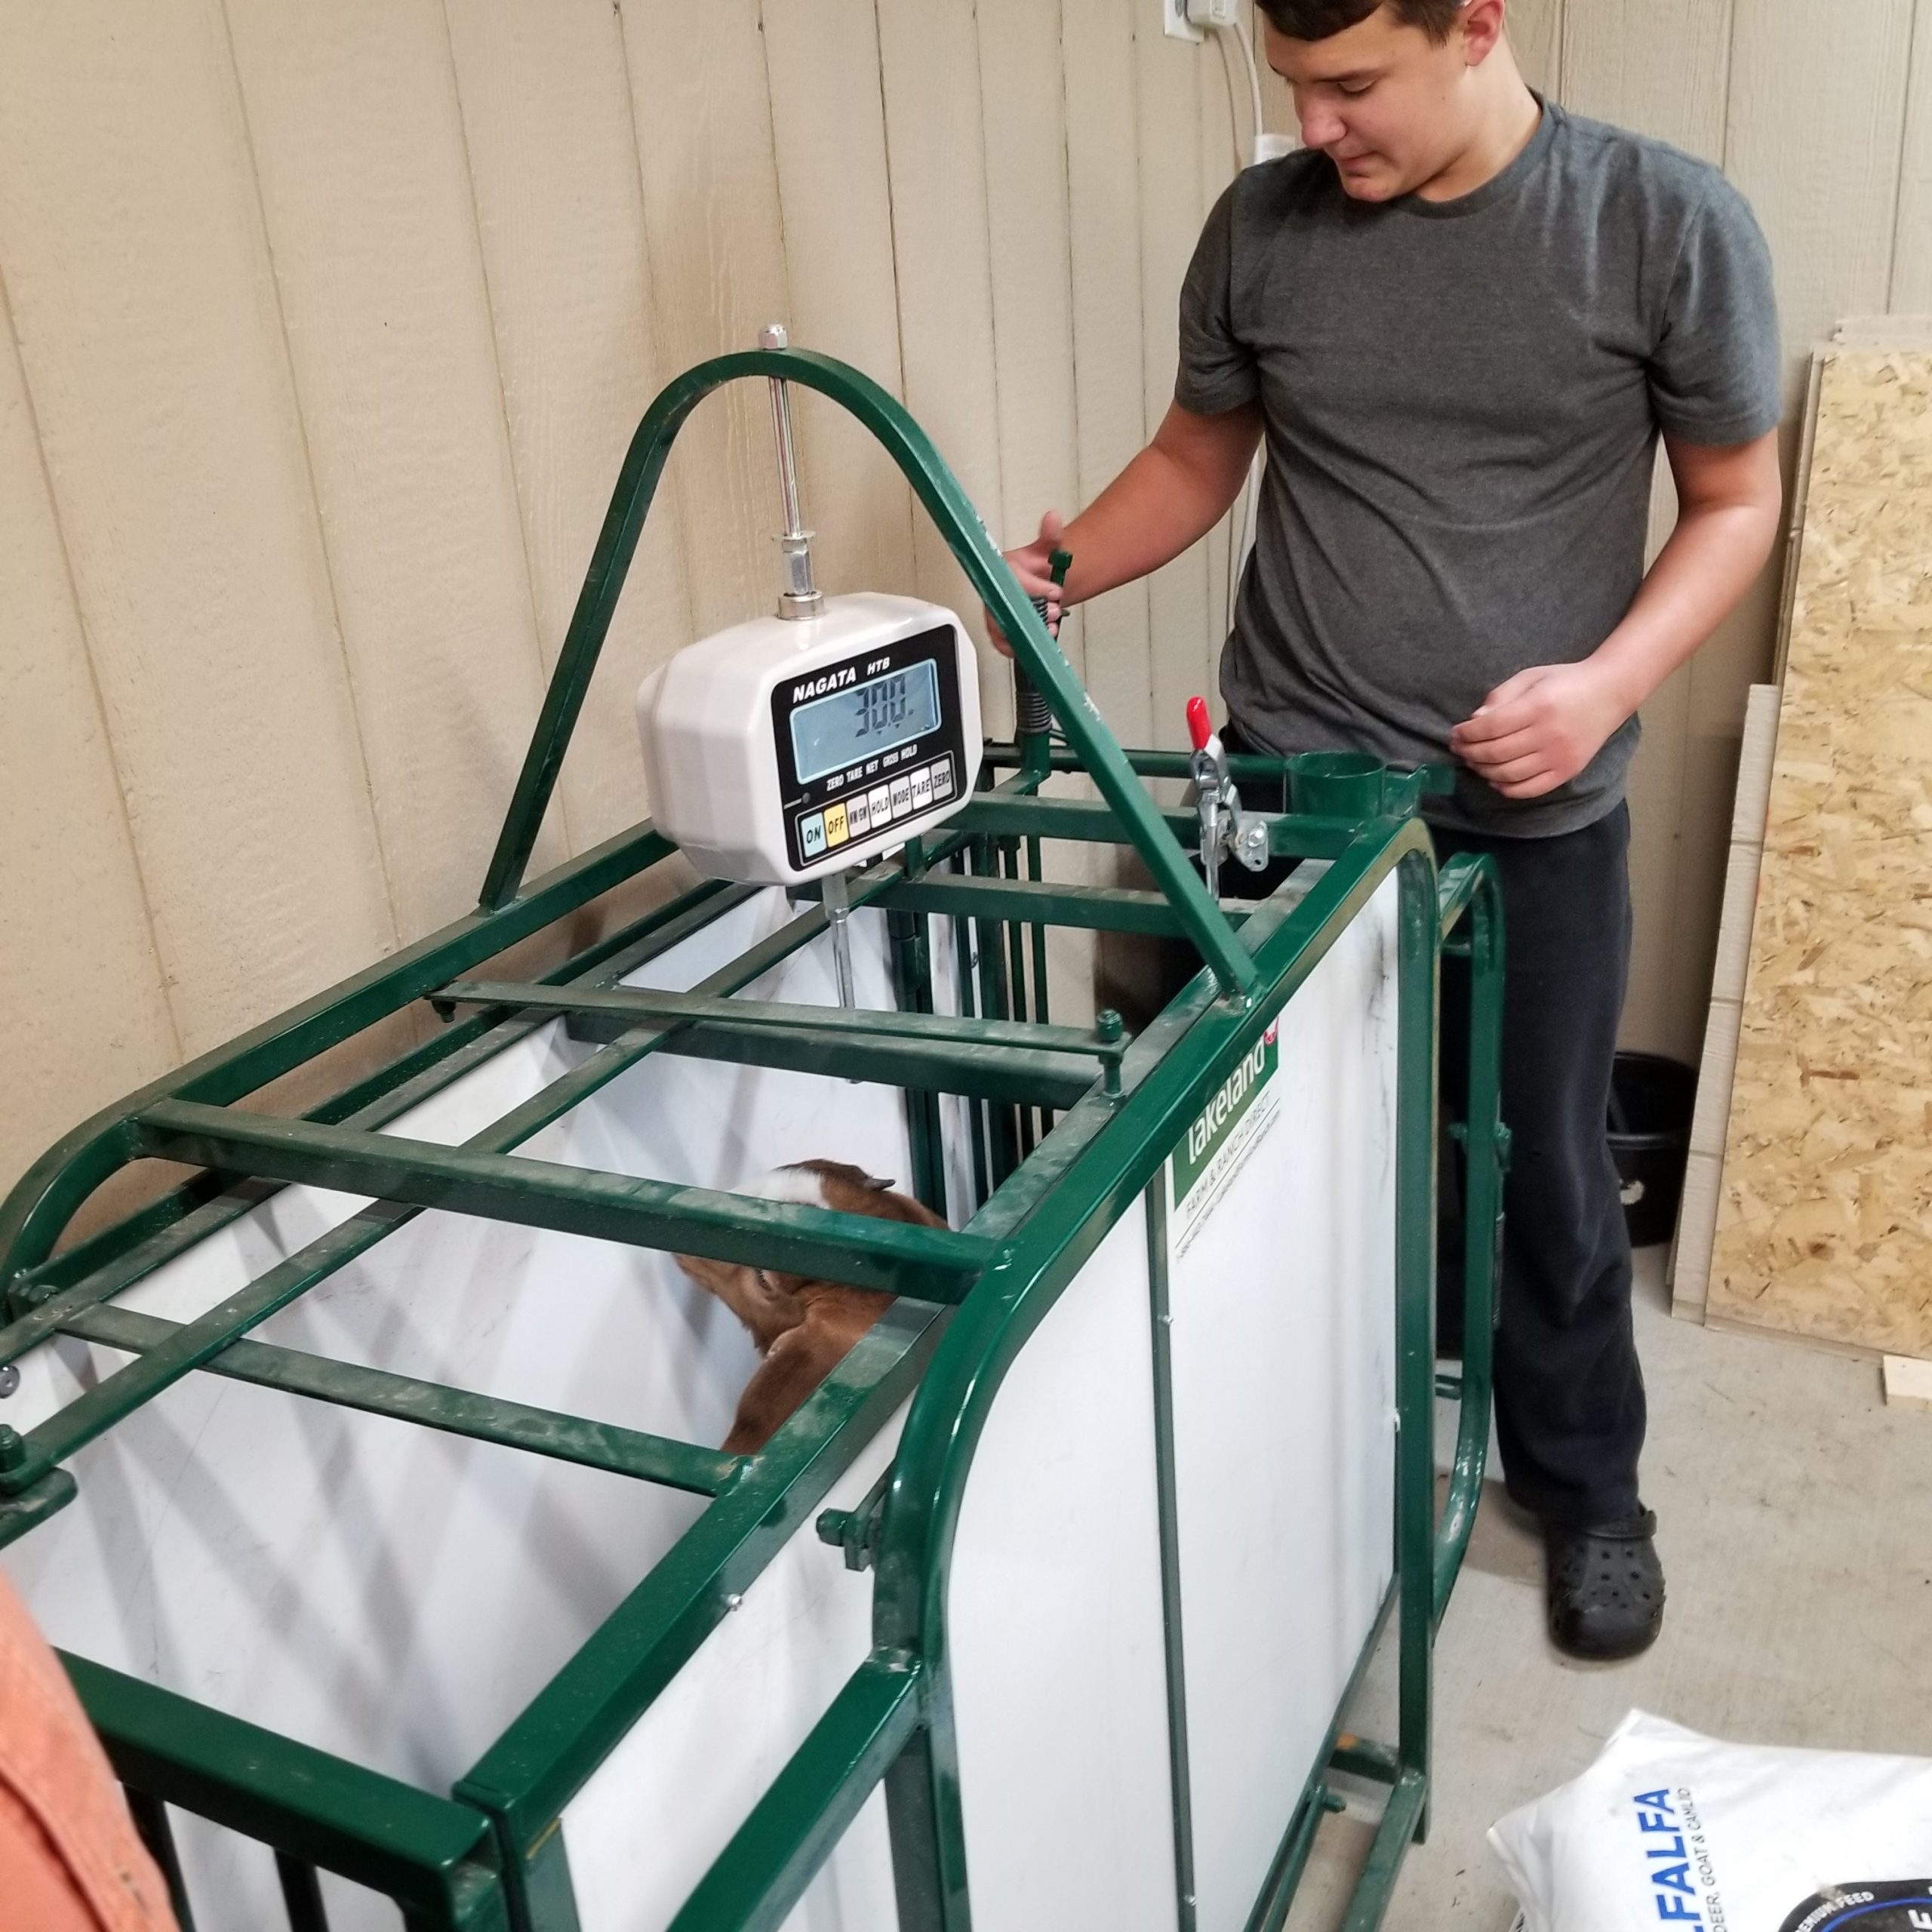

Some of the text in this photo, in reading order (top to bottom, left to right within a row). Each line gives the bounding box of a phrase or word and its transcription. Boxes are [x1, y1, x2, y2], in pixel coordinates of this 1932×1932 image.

[792, 657, 891, 703] NAGATA HTB
[826, 774, 844, 792] ZERO
[846, 766, 863, 783] TARE
[866, 759, 879, 775] NET
[900, 744, 918, 761] HOLD
[806, 825, 821, 844] ON
[828, 815, 844, 835] OFF
[871, 796, 889, 816] HOLD
[893, 787, 909, 807] MODE
[912, 777, 931, 798] TARE
[934, 769, 951, 789] ZERO
[1188, 1036, 1266, 1164] lakeland
[1691, 1834, 1705, 1844] &
[1694, 1847, 1715, 1887] GOAT
[1835, 1891, 1875, 1909] FEED
